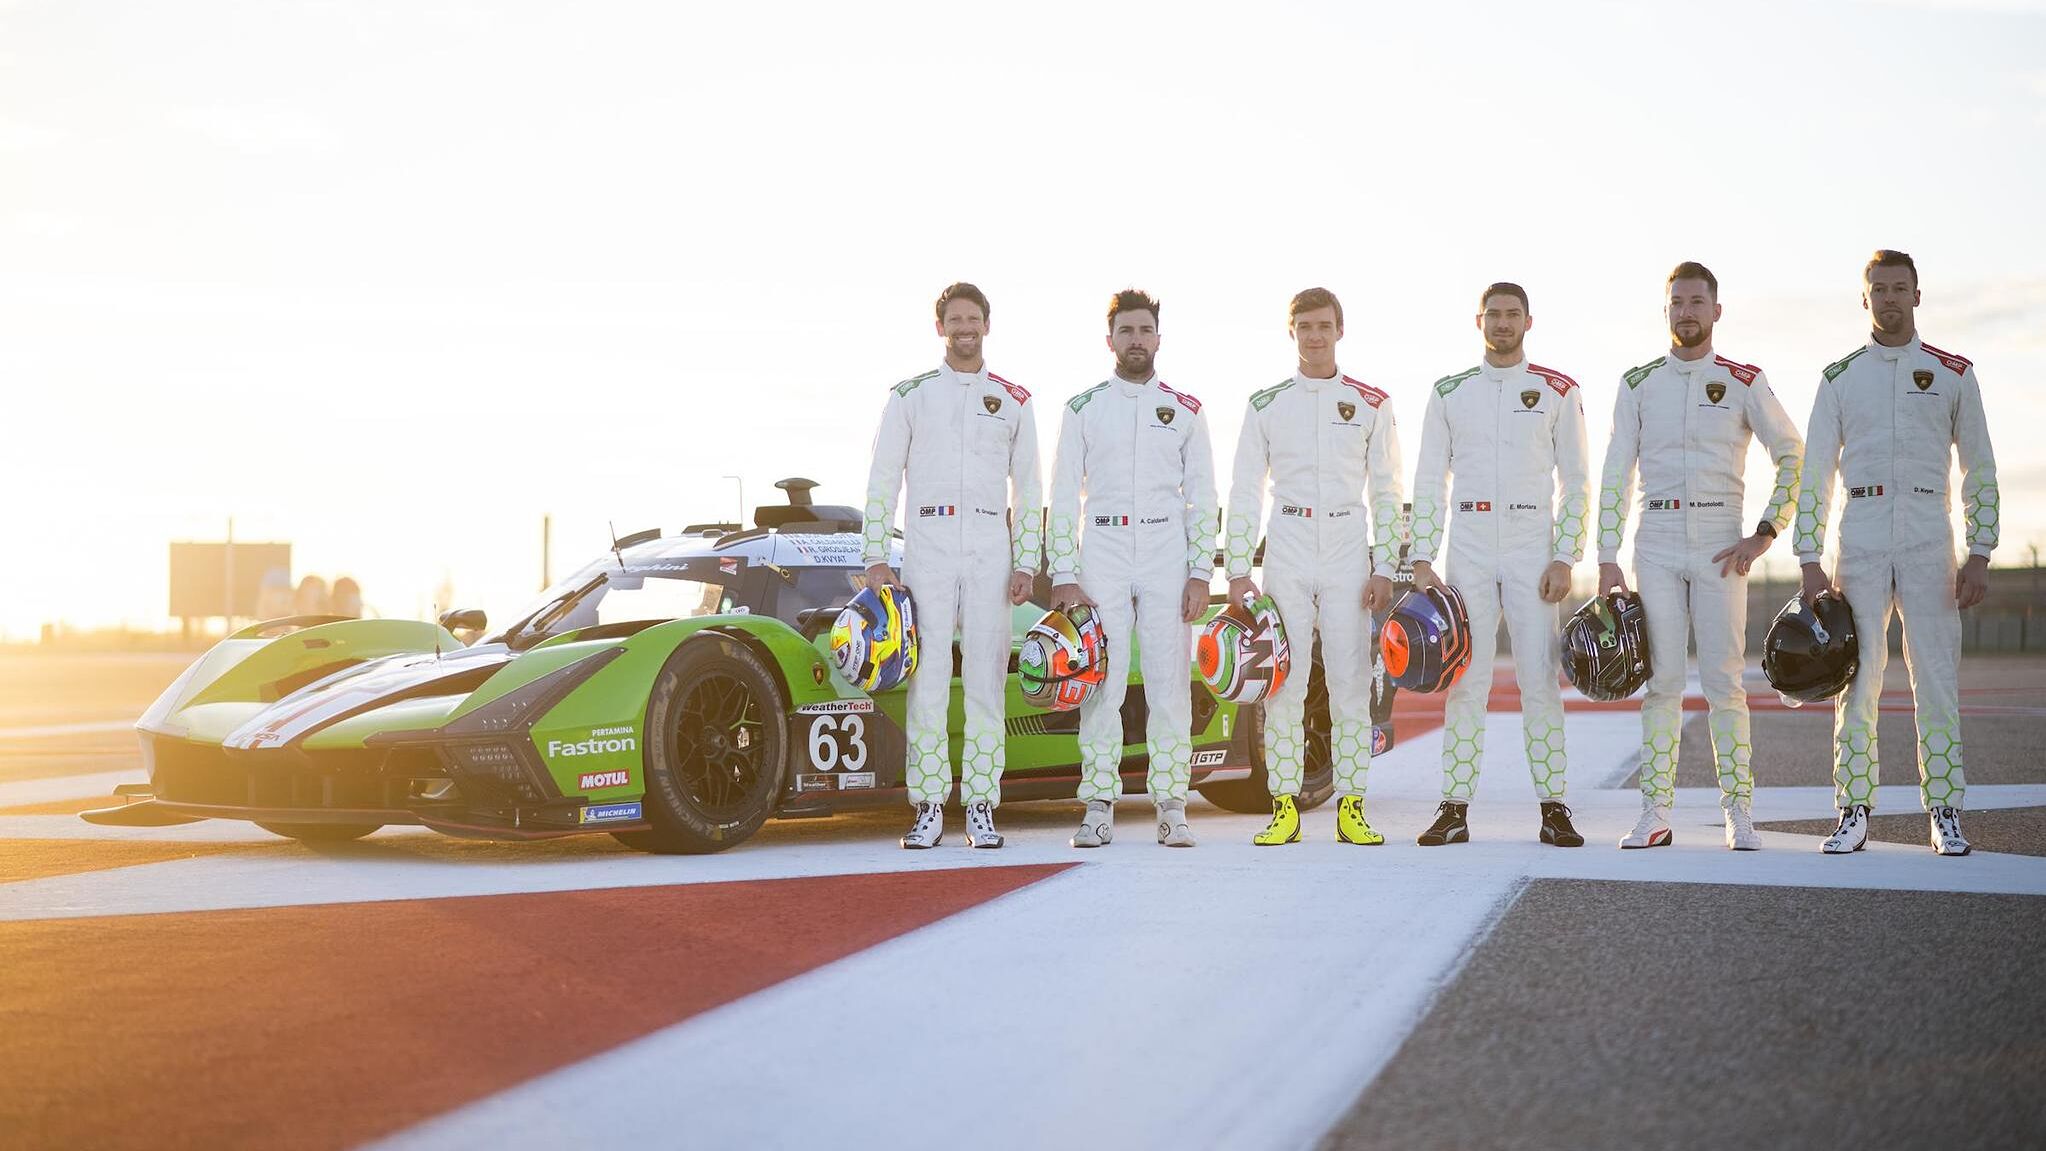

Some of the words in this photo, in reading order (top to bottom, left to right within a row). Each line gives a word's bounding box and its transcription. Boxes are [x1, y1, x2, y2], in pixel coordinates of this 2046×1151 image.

[920, 507, 936, 515] OMP
[1394, 573, 1414, 582] stro
[801, 702, 872, 711] WeatherTech
[592, 726, 634, 737] PERTAMINA
[548, 738, 636, 758] Fastron
[809, 714, 868, 771] 63
[1200, 752, 1224, 763] GTP
[580, 771, 629, 789] MOTUL
[597, 807, 637, 817] MICHELIN
